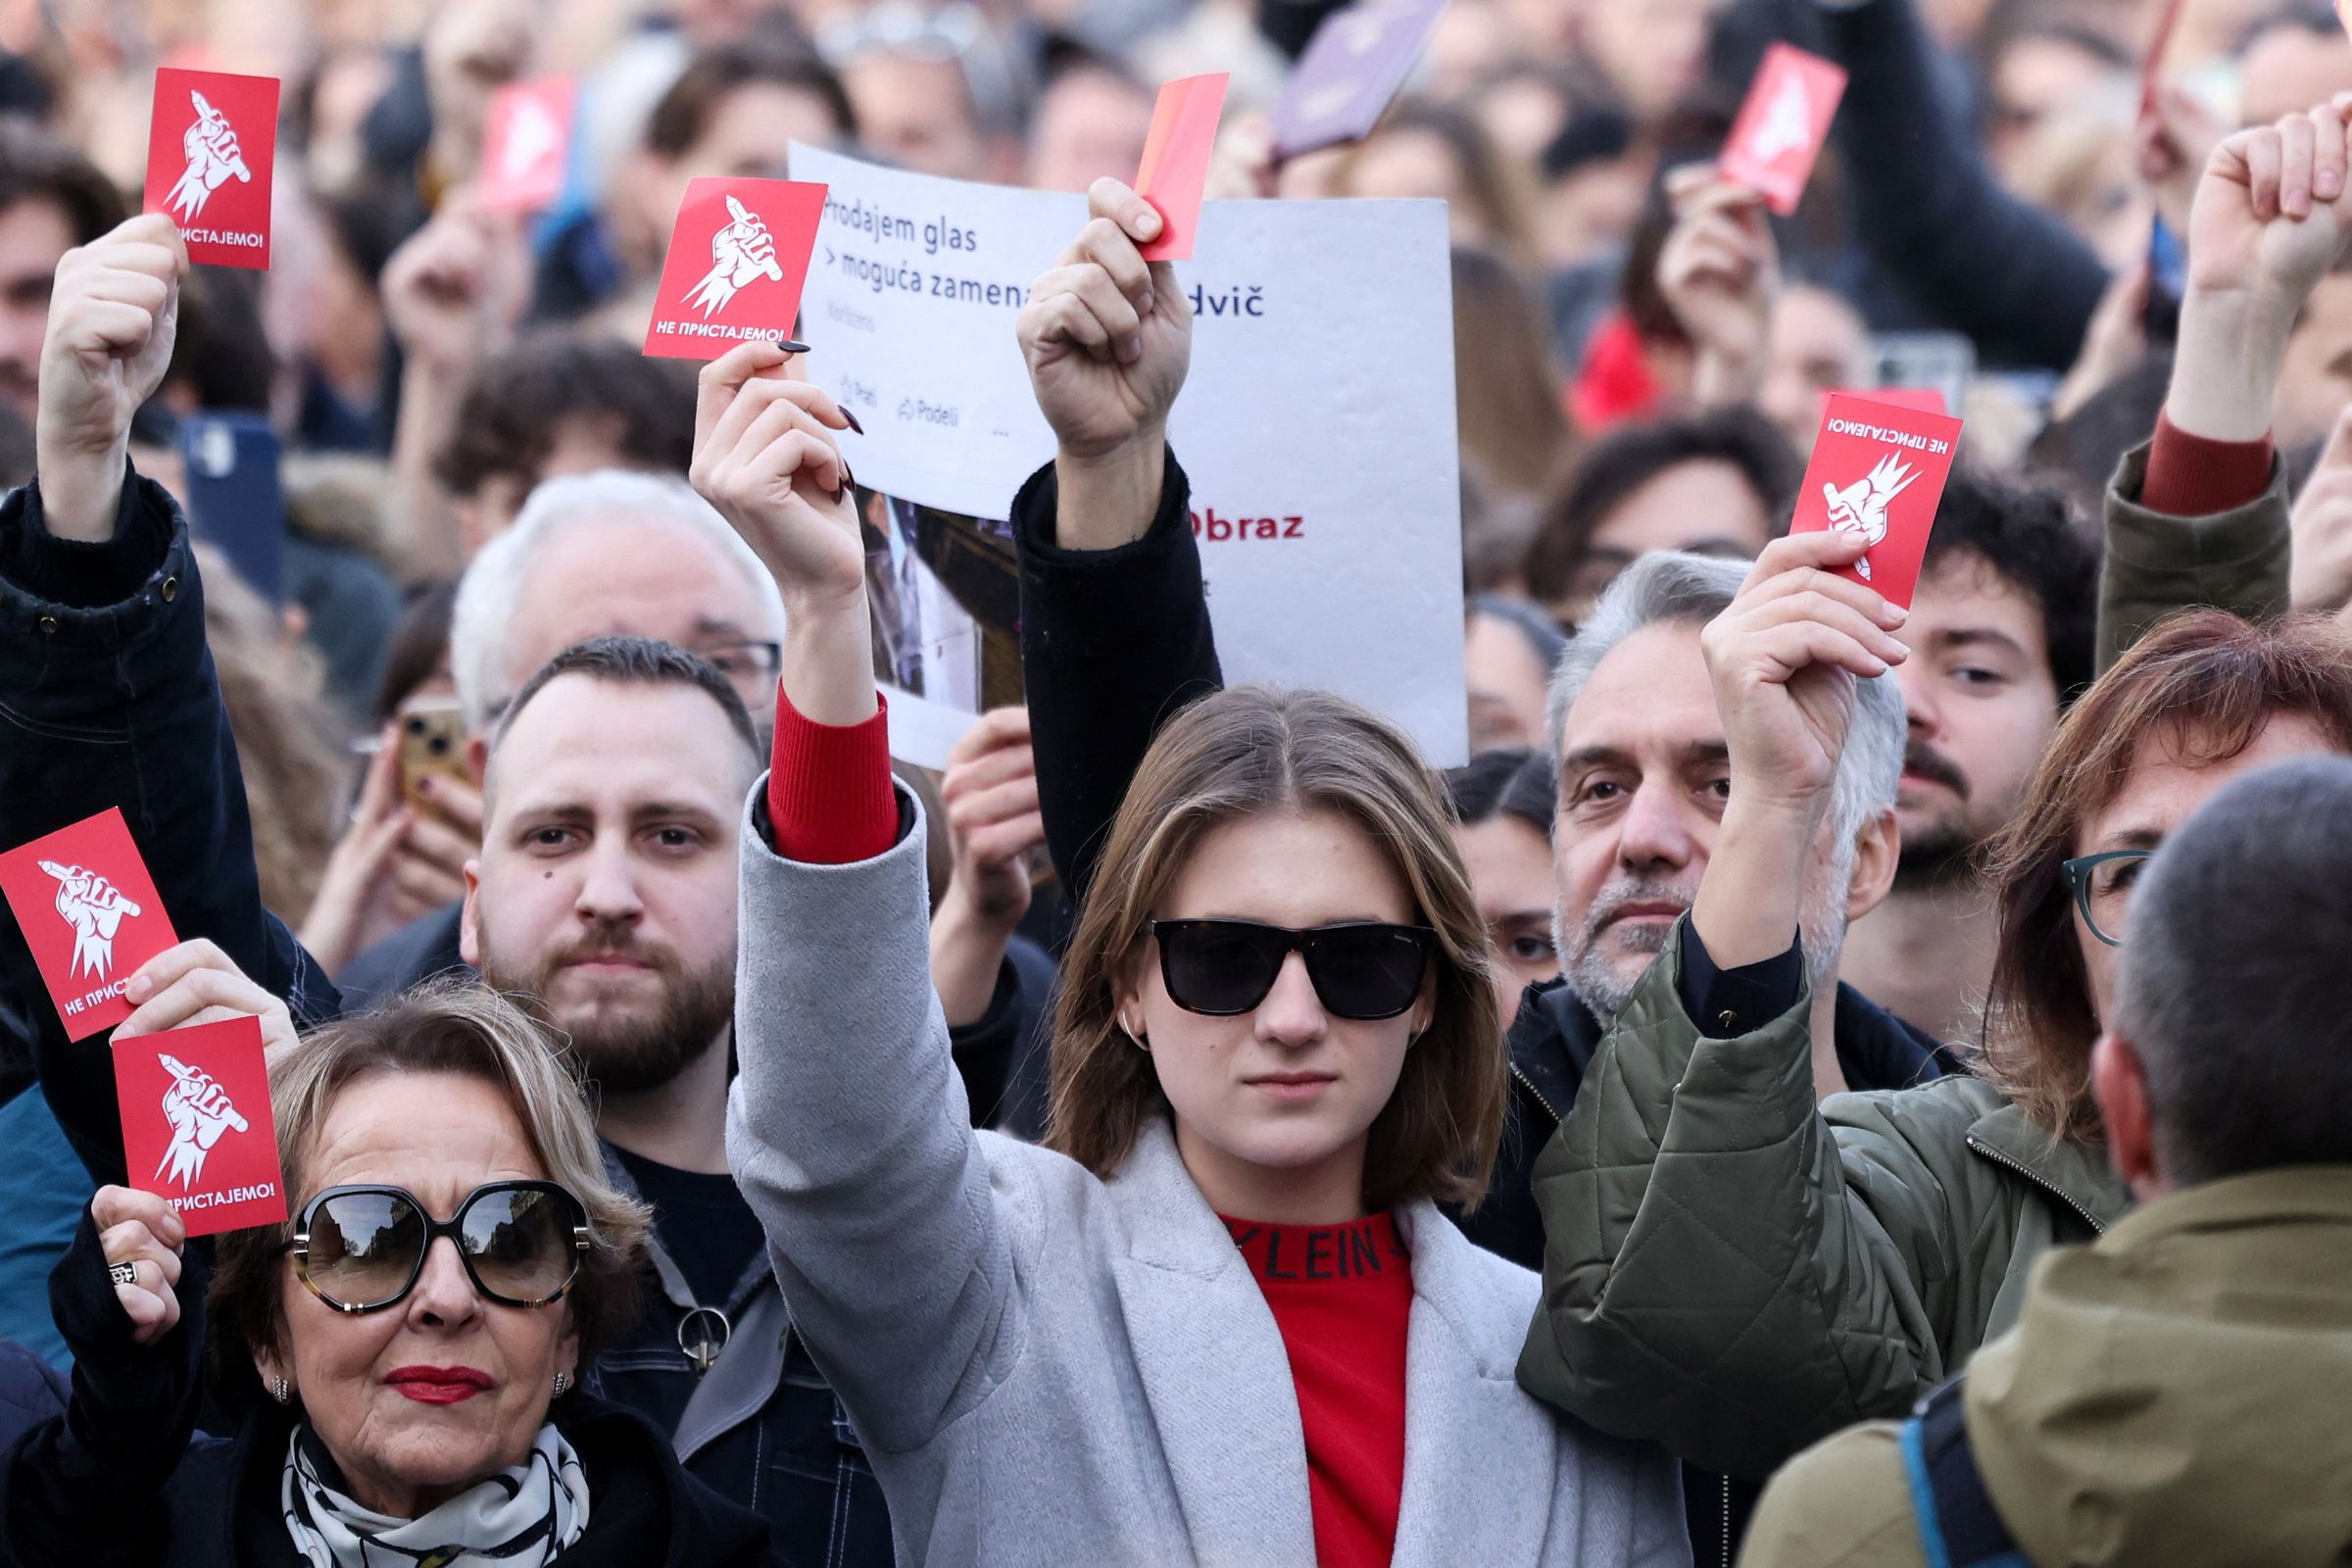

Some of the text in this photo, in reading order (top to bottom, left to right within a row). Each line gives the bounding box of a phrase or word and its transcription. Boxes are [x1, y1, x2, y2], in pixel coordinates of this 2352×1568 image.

[178, 227, 264, 248] ИСТАЈЕМО!
[824, 192, 977, 255] Prodajem glas
[842, 254, 922, 293] moguća
[930, 273, 1031, 309] zamen
[1188, 284, 1264, 316] dvič
[656, 320, 784, 343] НЕ ПРИСТАЈЕМО!
[1827, 417, 1949, 455] НЕ ПРИСТАЈЕМО!
[64, 977, 129, 1016] НЕ ПРИС
